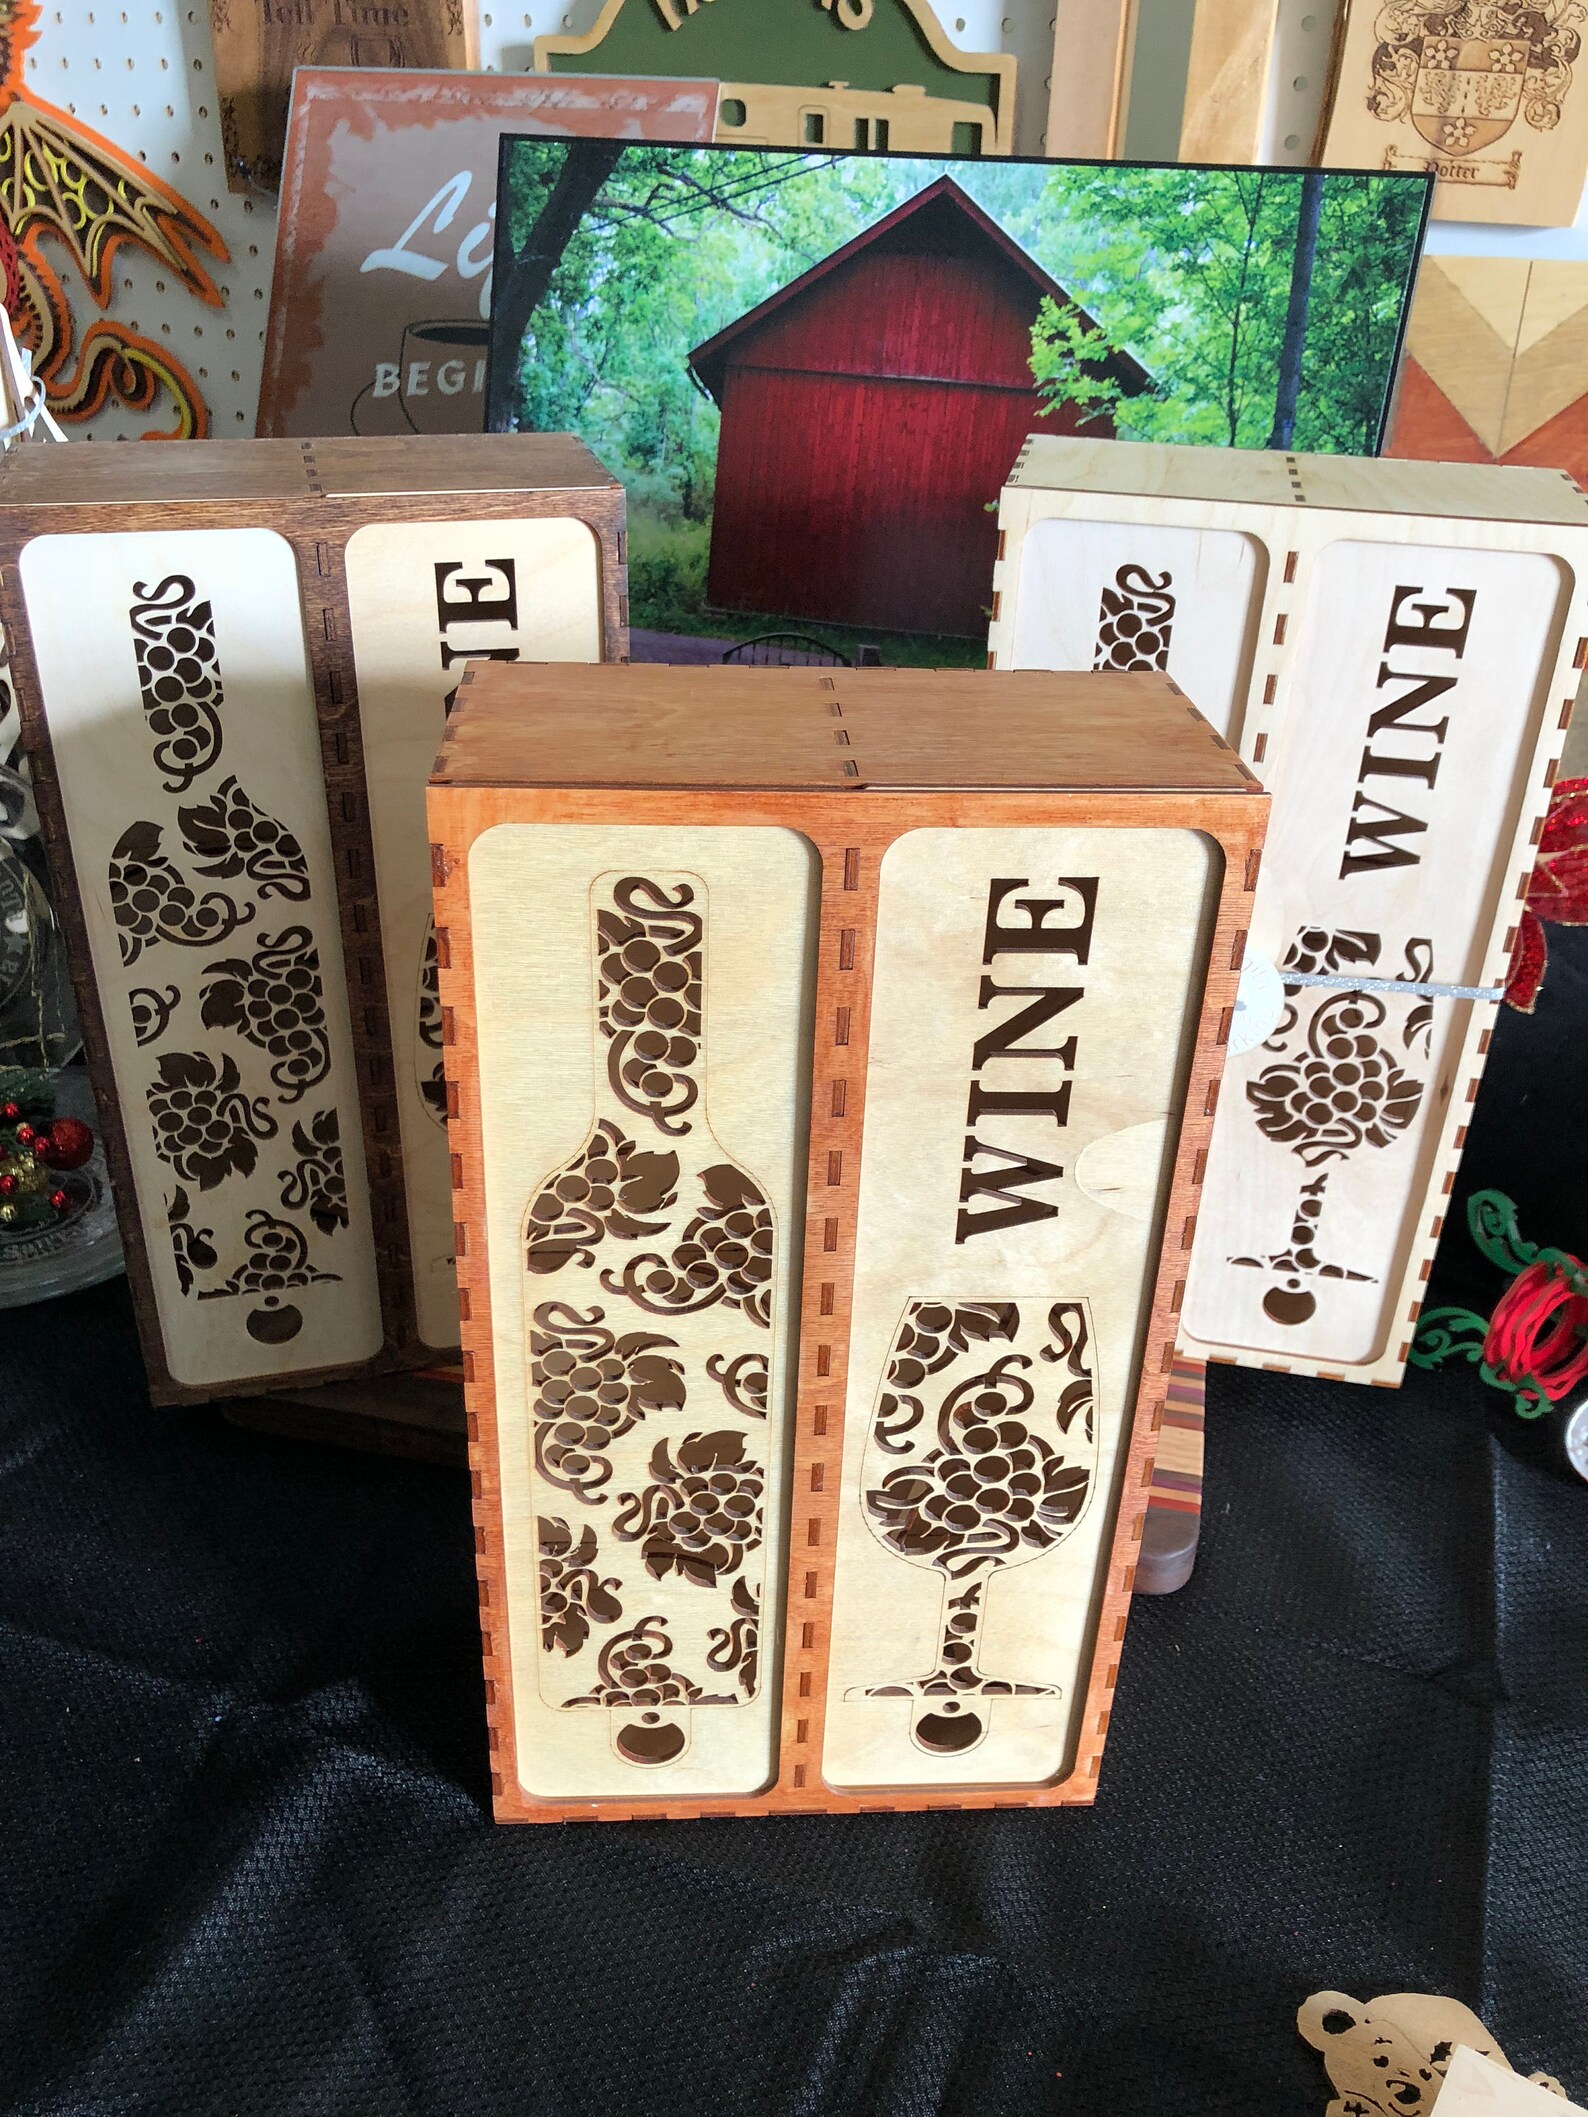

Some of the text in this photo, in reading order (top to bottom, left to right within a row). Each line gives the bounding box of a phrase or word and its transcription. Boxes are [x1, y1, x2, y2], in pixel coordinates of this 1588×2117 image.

[359, 170, 497, 320] Li
[1338, 585, 1477, 880] WINE
[955, 877, 1100, 1245] WINE
